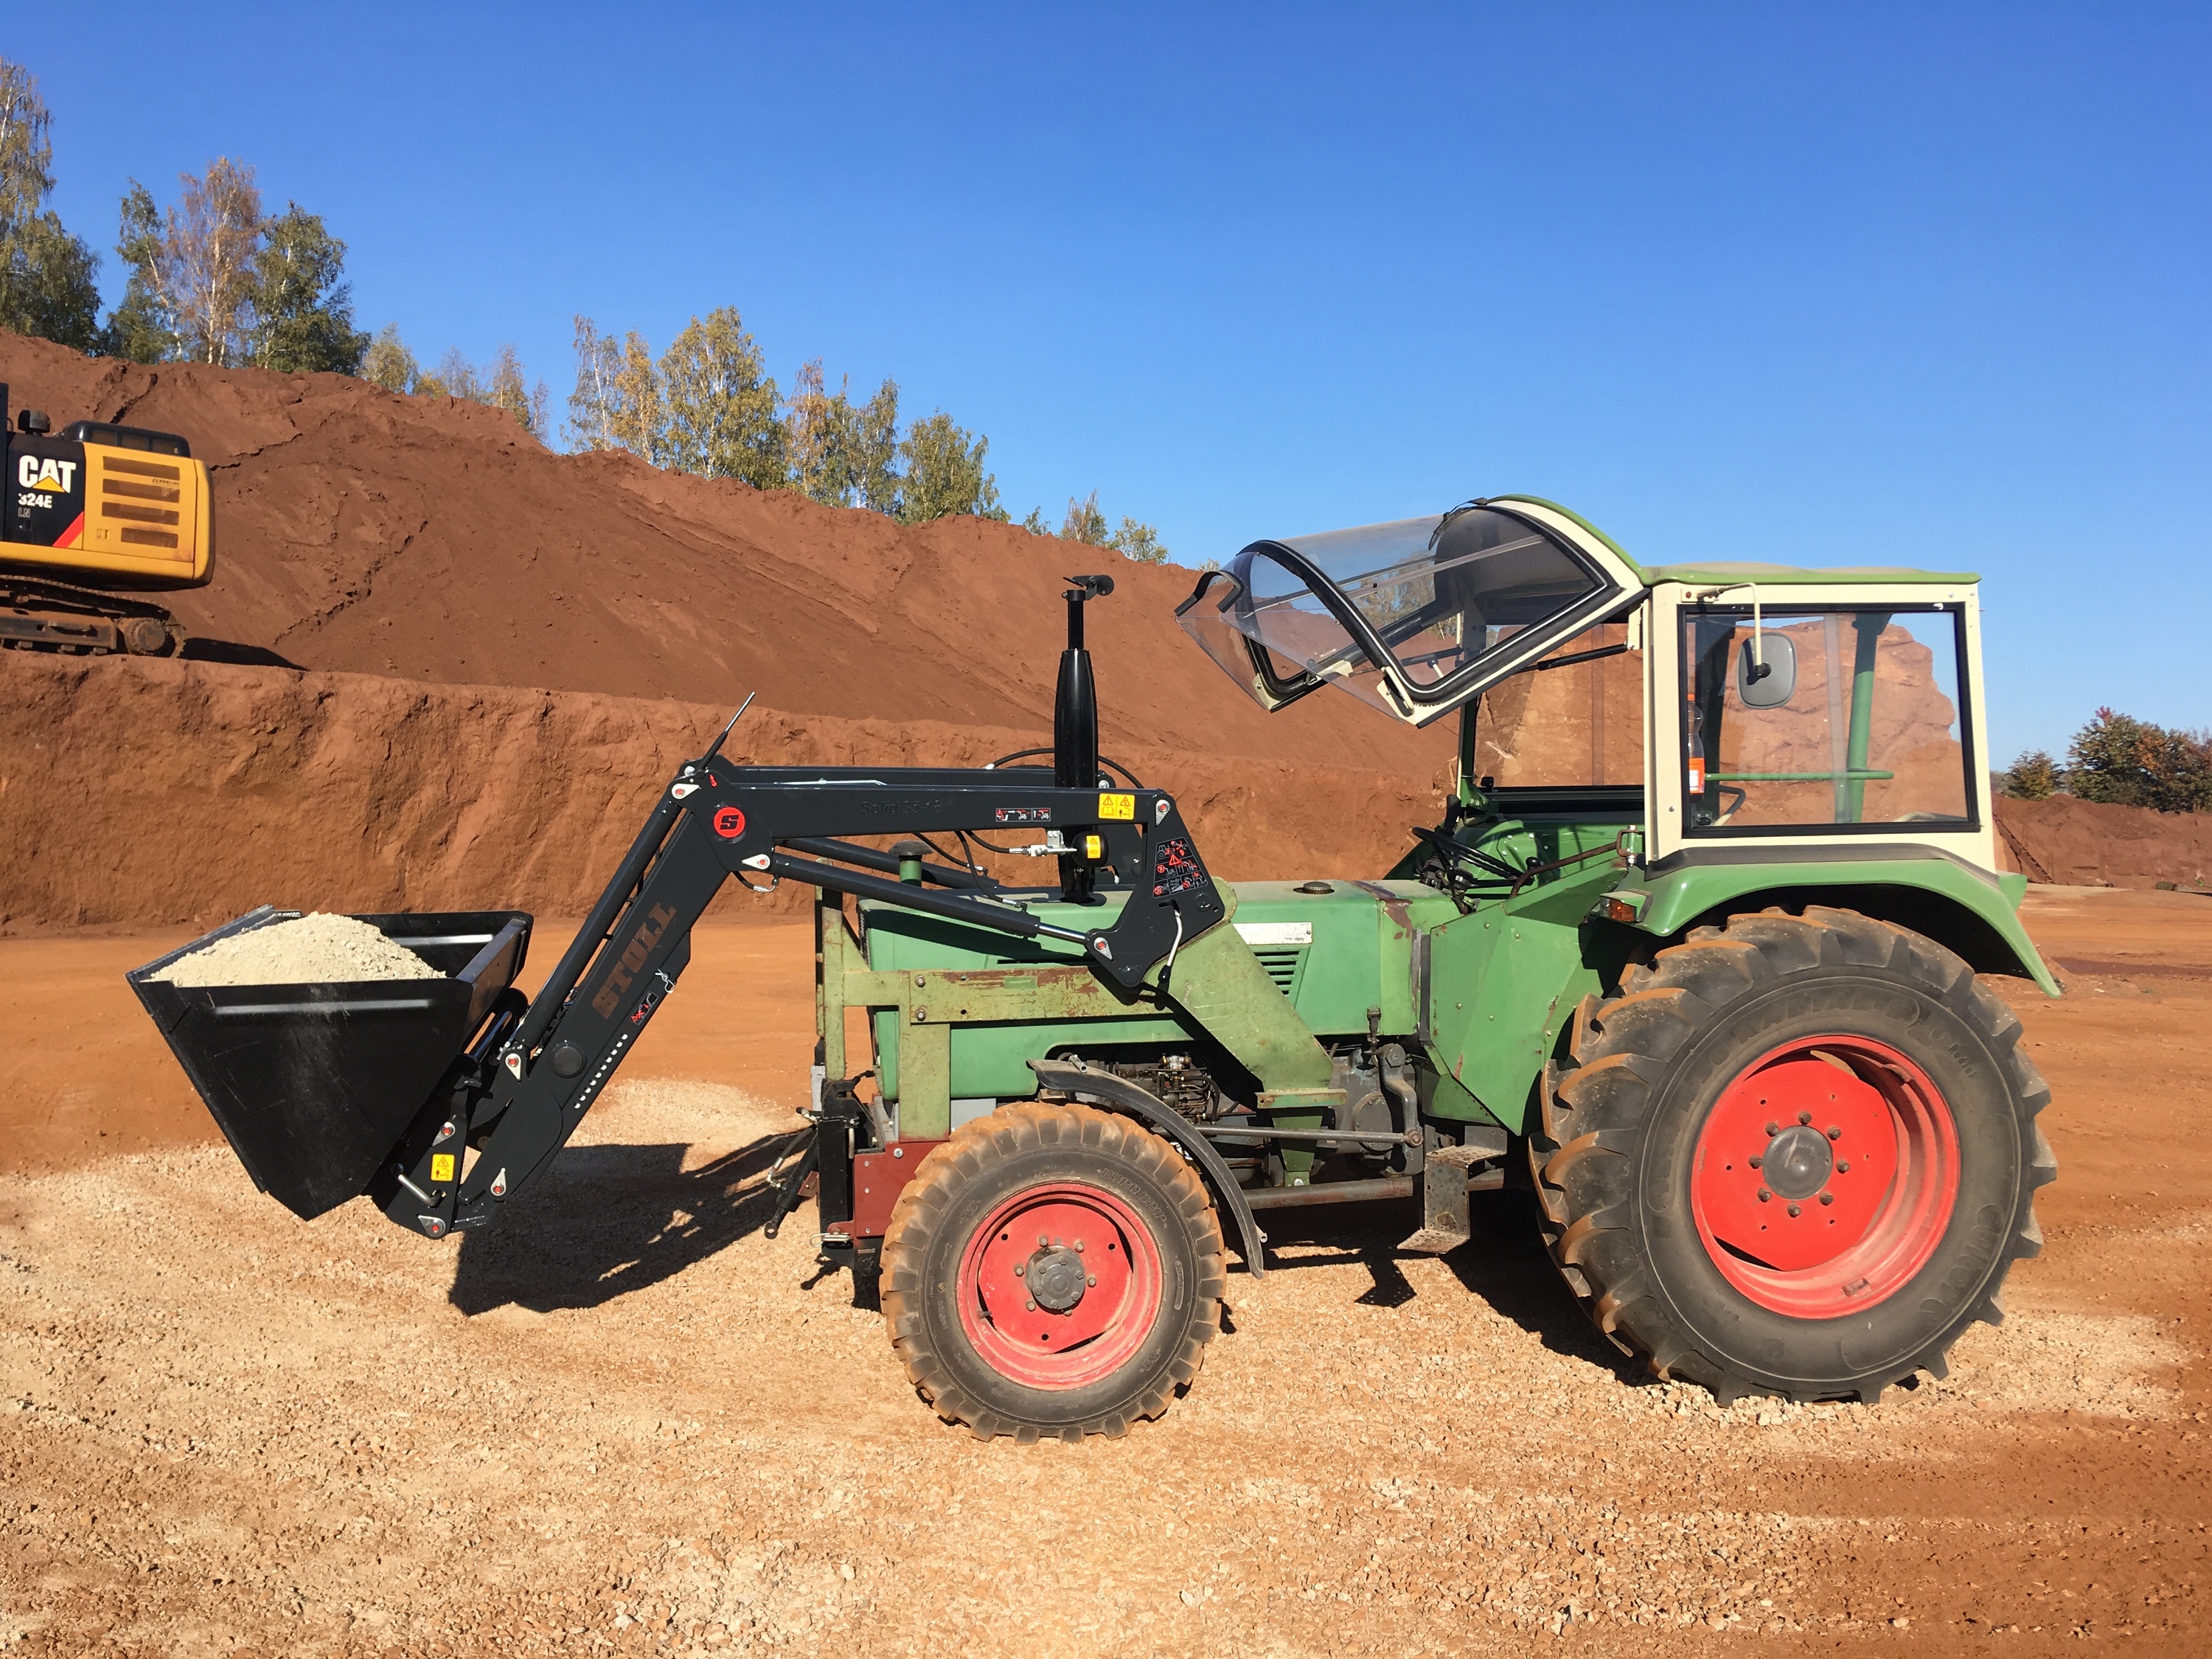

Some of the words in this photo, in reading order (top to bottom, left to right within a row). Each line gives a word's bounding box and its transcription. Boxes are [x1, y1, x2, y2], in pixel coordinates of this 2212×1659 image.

[18, 455, 77, 493] CAT
[18, 493, 53, 509] 324E
[859, 800, 900, 815] Solid
[591, 901, 677, 1020] STOLL
[1101, 1168, 1140, 1194] EURO
